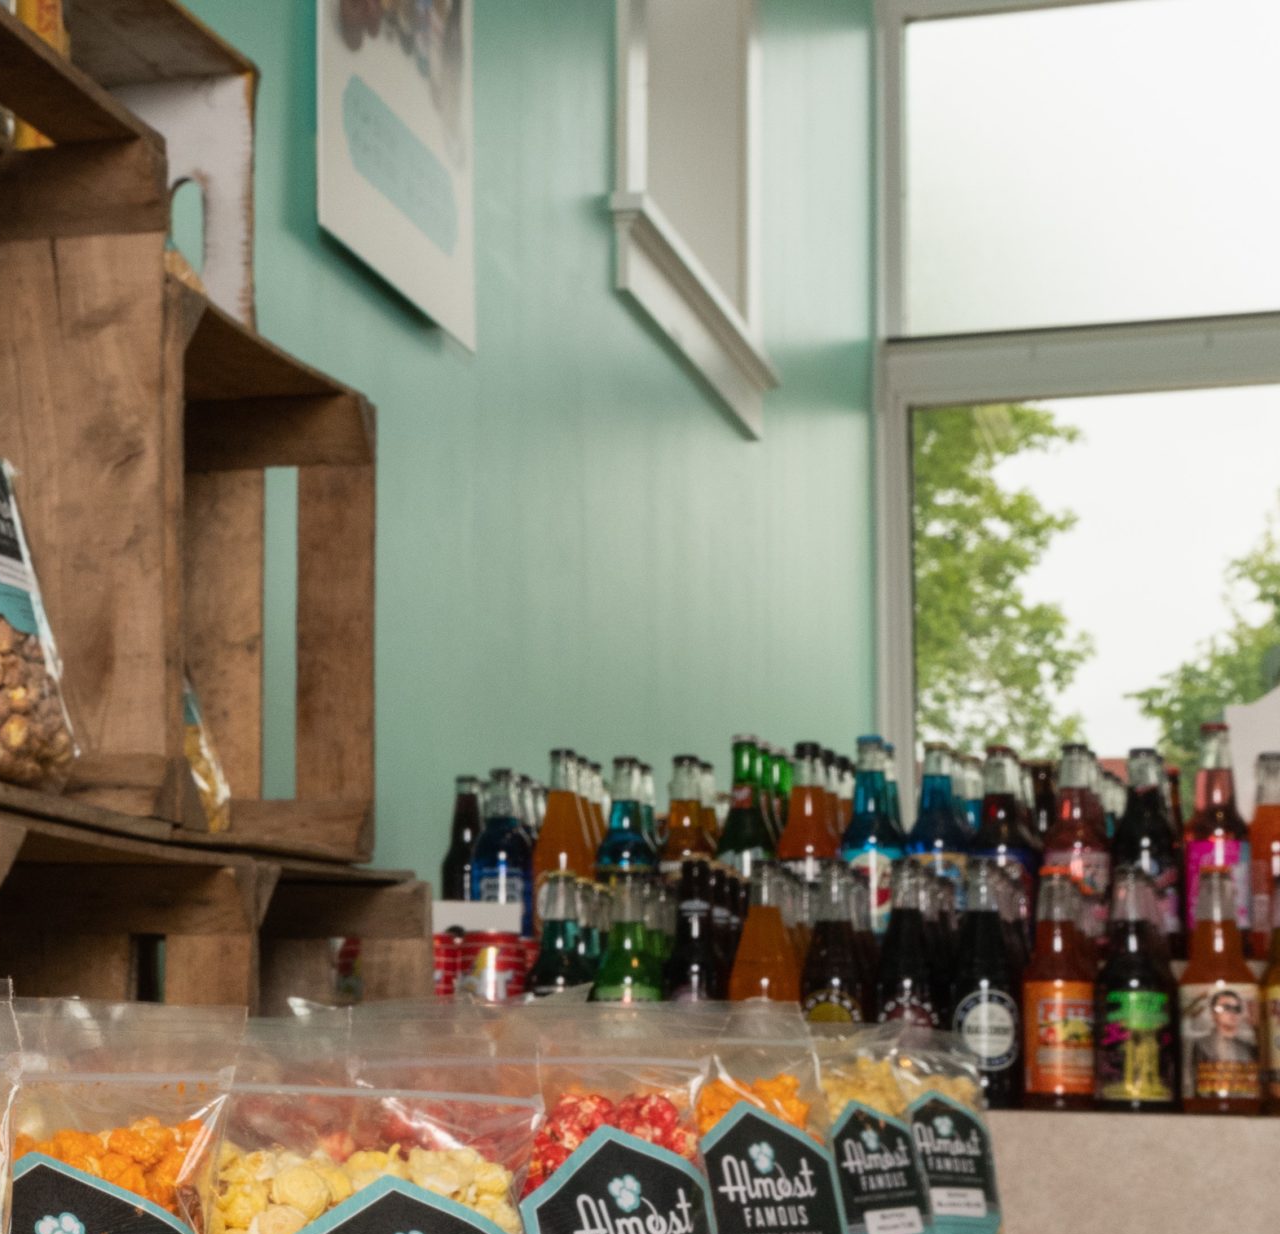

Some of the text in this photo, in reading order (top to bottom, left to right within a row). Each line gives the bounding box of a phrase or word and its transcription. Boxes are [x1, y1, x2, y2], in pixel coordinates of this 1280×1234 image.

[841, 1136, 910, 1174] Almost
[912, 1121, 981, 1157] Almost
[718, 1154, 817, 1205] Almost
[861, 1171, 907, 1191] FAMOUS
[743, 1204, 810, 1229] FAMOUS
